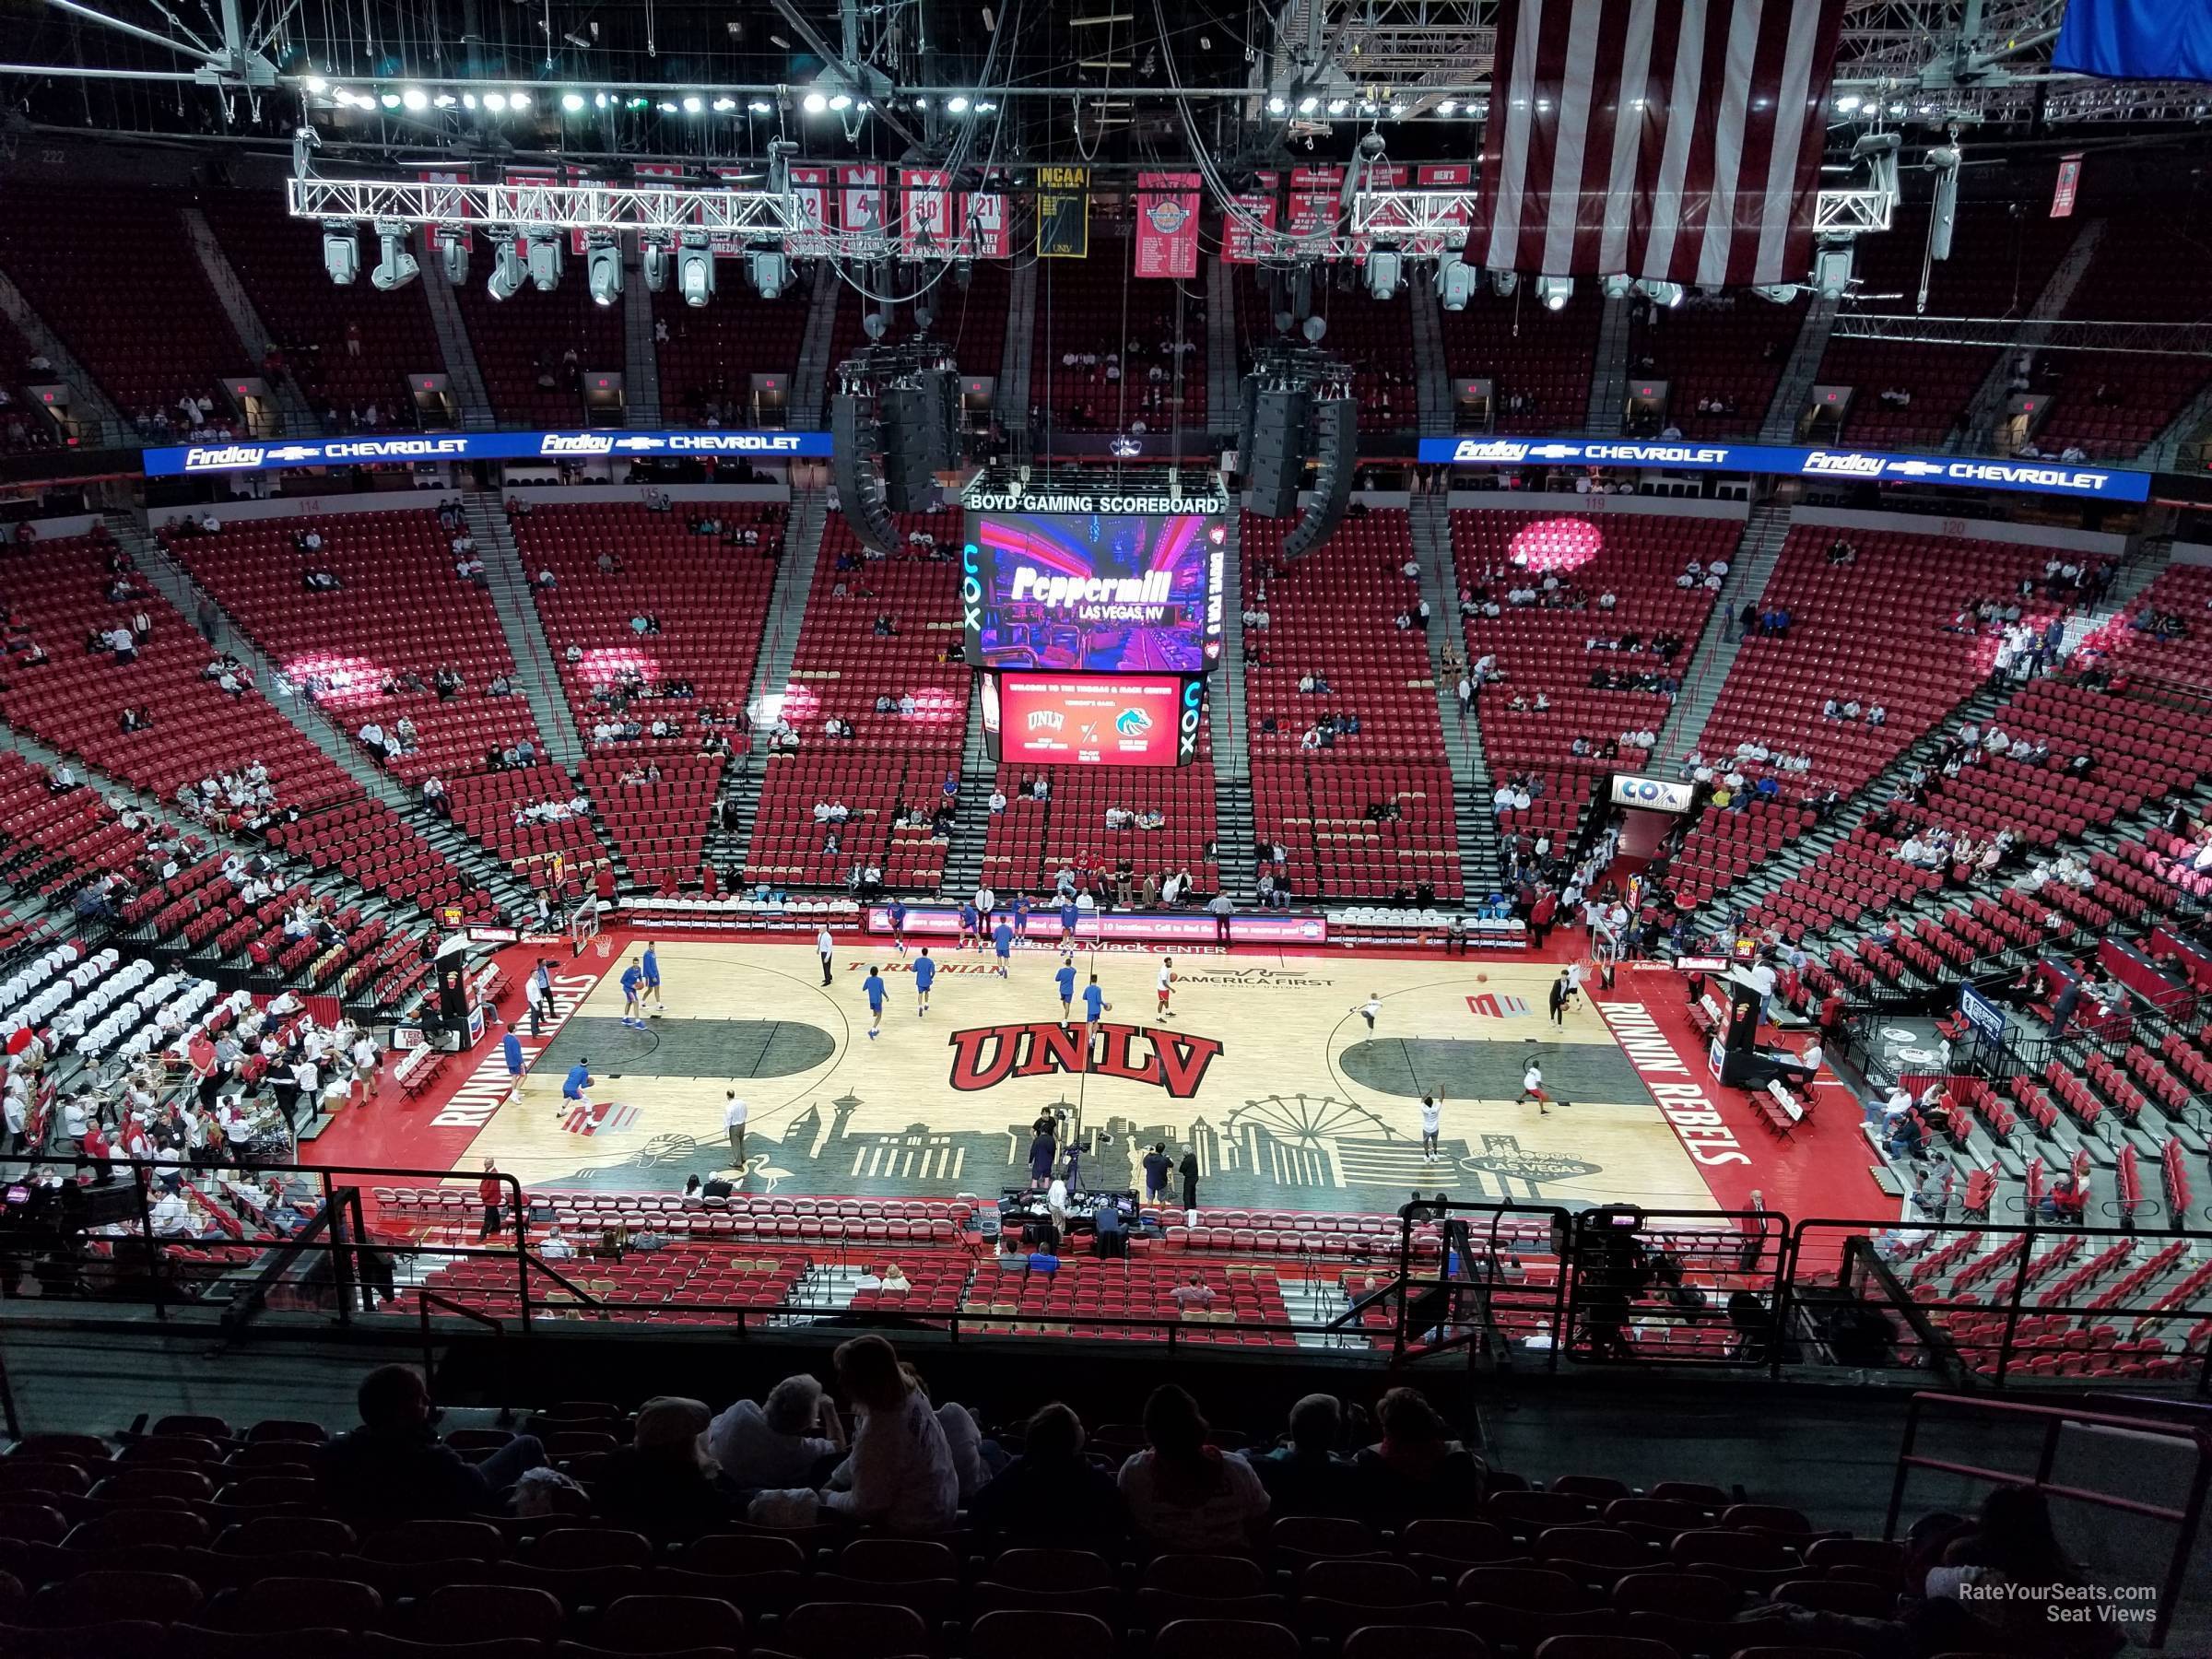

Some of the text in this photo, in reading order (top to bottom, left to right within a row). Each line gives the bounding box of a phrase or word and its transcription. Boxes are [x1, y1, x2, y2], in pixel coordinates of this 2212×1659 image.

[1042, 168, 1084, 182] NCAA
[1434, 171, 1454, 180] MEN'S
[857, 194, 868, 214] 4
[977, 197, 994, 217] 21
[541, 433, 800, 452] Findlay CHEVROLET
[1453, 440, 1729, 463] Findlay CHEVROLET
[185, 440, 467, 466] Findlay CHEVROLET
[1804, 452, 2109, 489] Findlay CHEVROLET
[641, 488, 658, 500] 115
[1585, 497, 1606, 510] 119
[300, 500, 319, 512] 114
[971, 495, 1219, 513] BOYD GAMING SCOREBOARD
[1942, 521, 1965, 535] 120
[964, 545, 981, 630] COX
[1011, 567, 1172, 608] Peppermill
[1079, 606, 1164, 619] LAS VEGAS, NV
[1028, 711, 1065, 731] UNLV
[1181, 681, 1201, 756] COX
[1622, 781, 1677, 805] COX
[1103, 923, 1114, 931] 10
[1082, 940, 1150, 952] Mack
[1153, 944, 1228, 954] CENTER
[1739, 947, 1750, 956] 30
[1176, 976, 1335, 987] AMERICA FIRST
[1596, 1002, 1691, 1077] RUNNIN'
[948, 1021, 1224, 1099] UNLV
[1648, 1082, 1752, 1165] REBELS
[1483, 1162, 1586, 1173] LAS VEGAS
